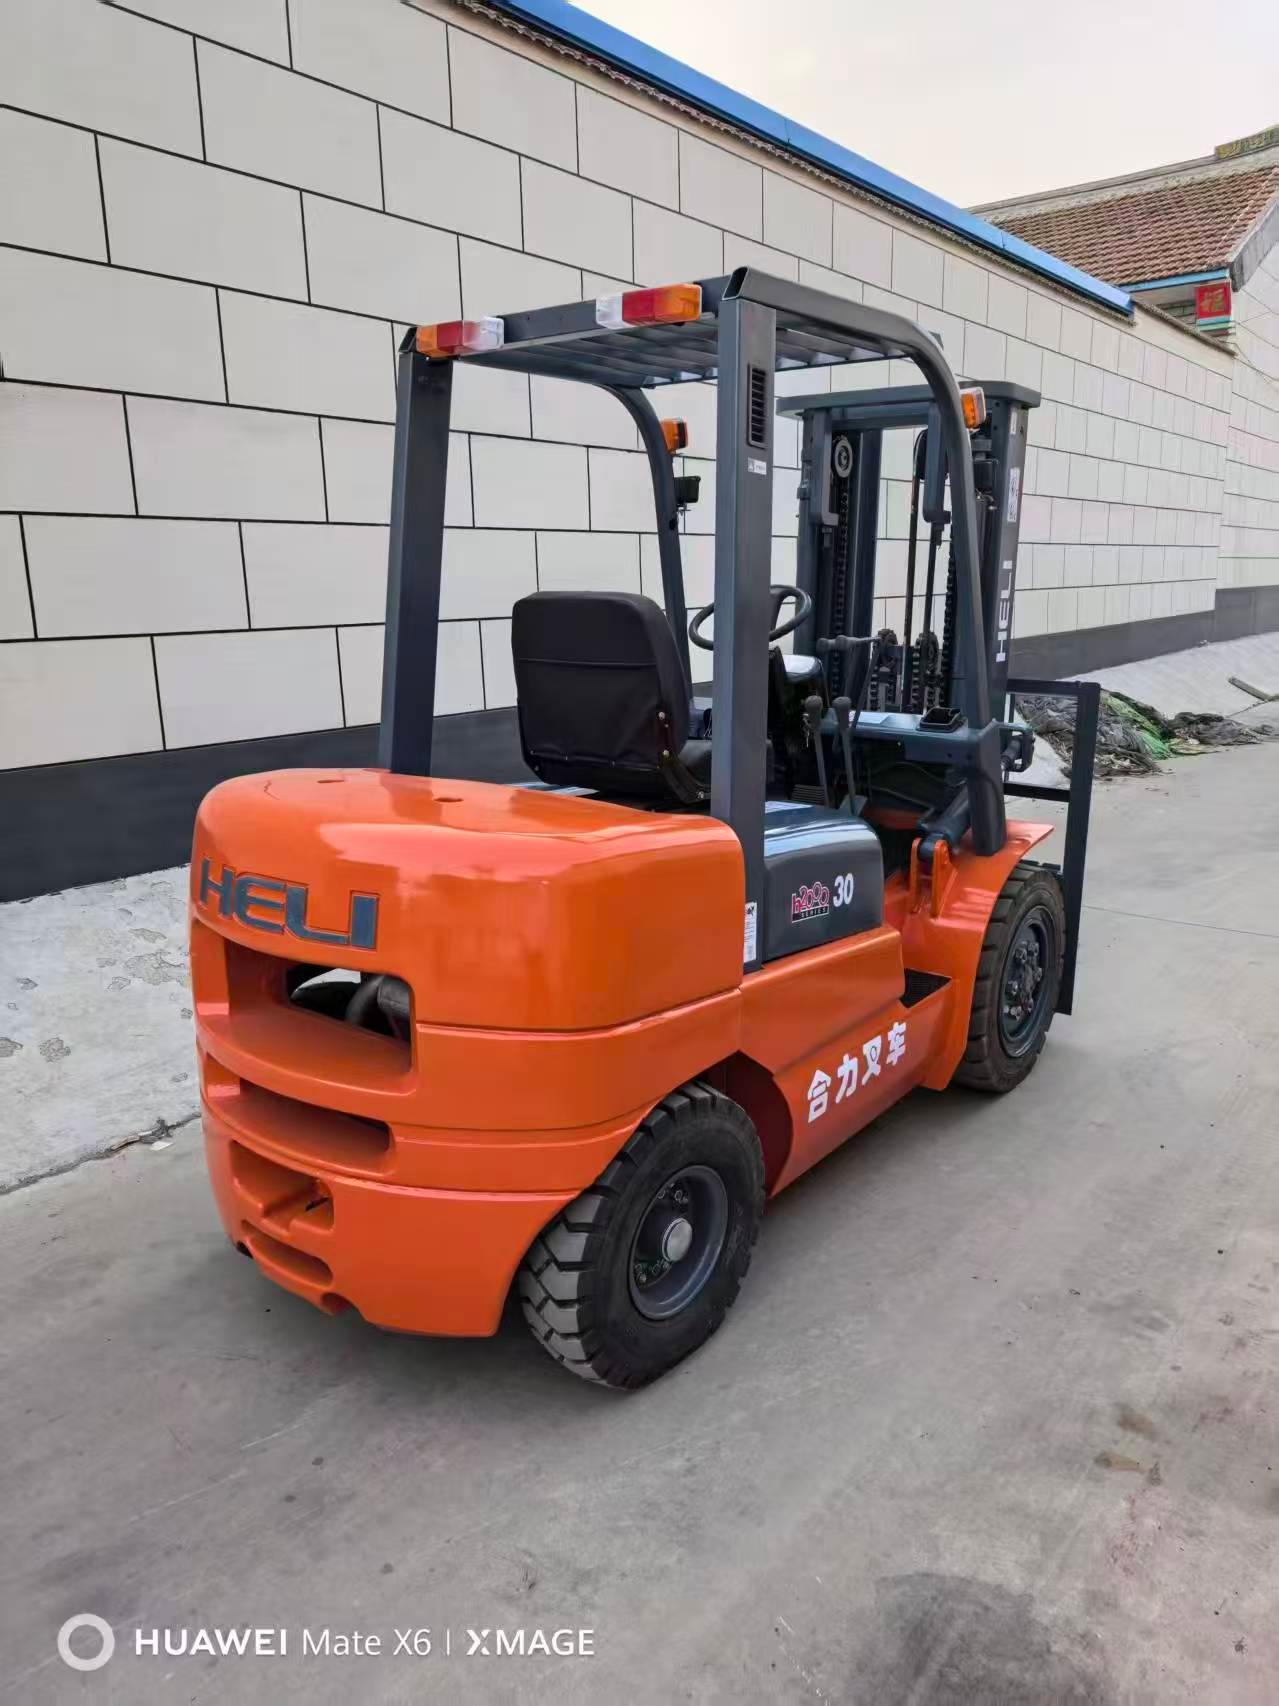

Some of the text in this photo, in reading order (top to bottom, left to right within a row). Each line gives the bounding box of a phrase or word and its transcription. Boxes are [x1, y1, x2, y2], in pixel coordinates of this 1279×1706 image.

[995, 560, 1013, 662] HELI
[199, 856, 379, 950] HELI
[833, 873, 854, 908] 30
[807, 1021, 907, 1123] 合力叉车
